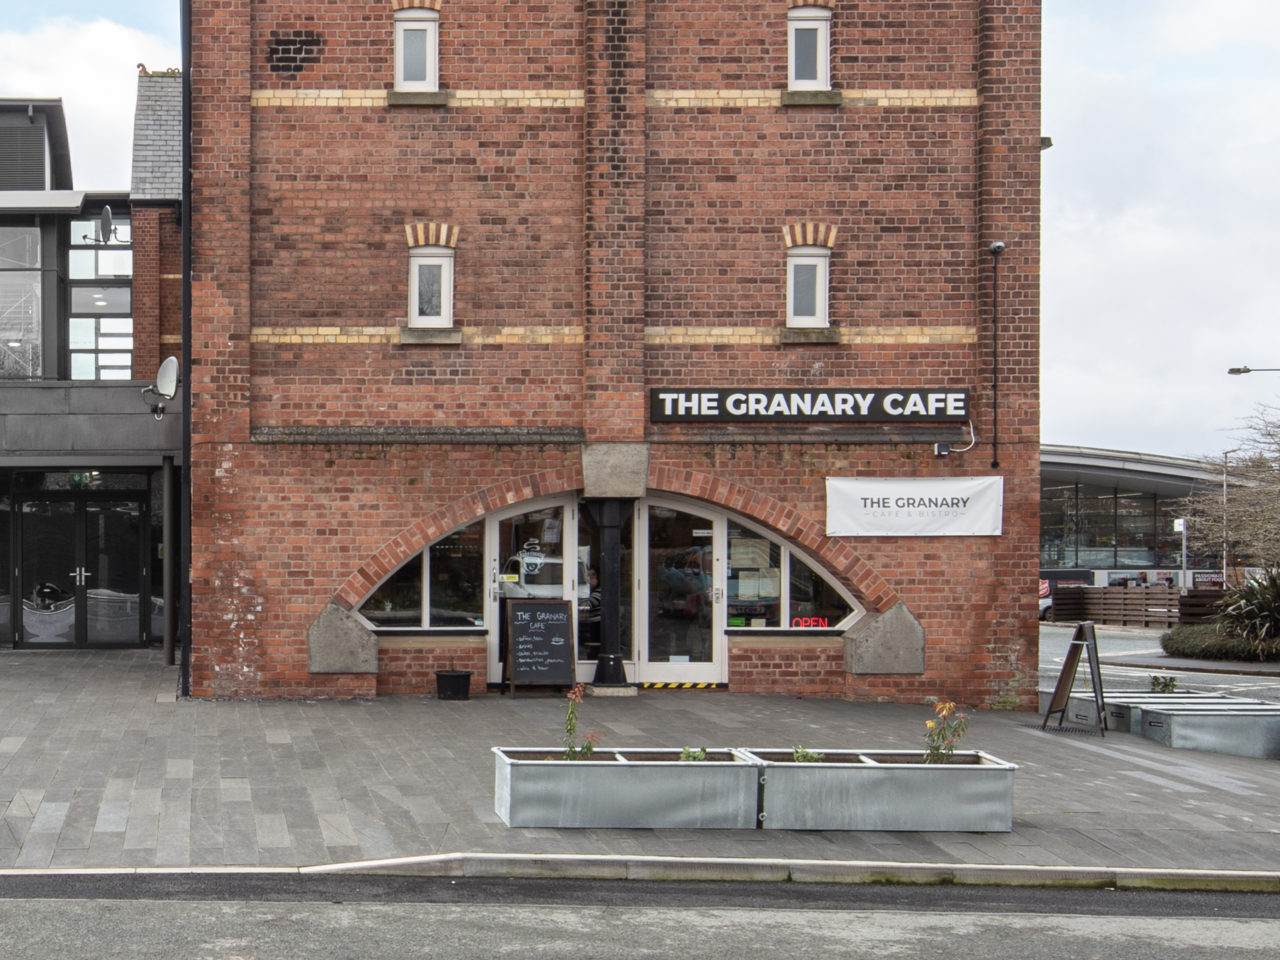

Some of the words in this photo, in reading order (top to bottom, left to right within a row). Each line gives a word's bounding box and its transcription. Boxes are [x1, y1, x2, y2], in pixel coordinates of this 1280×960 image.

[658, 393, 719, 416] THE
[725, 393, 875, 416] GRANARY
[882, 393, 966, 416] CAFE
[860, 497, 891, 508] THE
[895, 497, 970, 508] GRANARY
[918, 510, 959, 518] BISTRO
[516, 611, 532, 621] THE
[536, 611, 568, 621] GRANARY
[792, 617, 828, 629] OPEN
